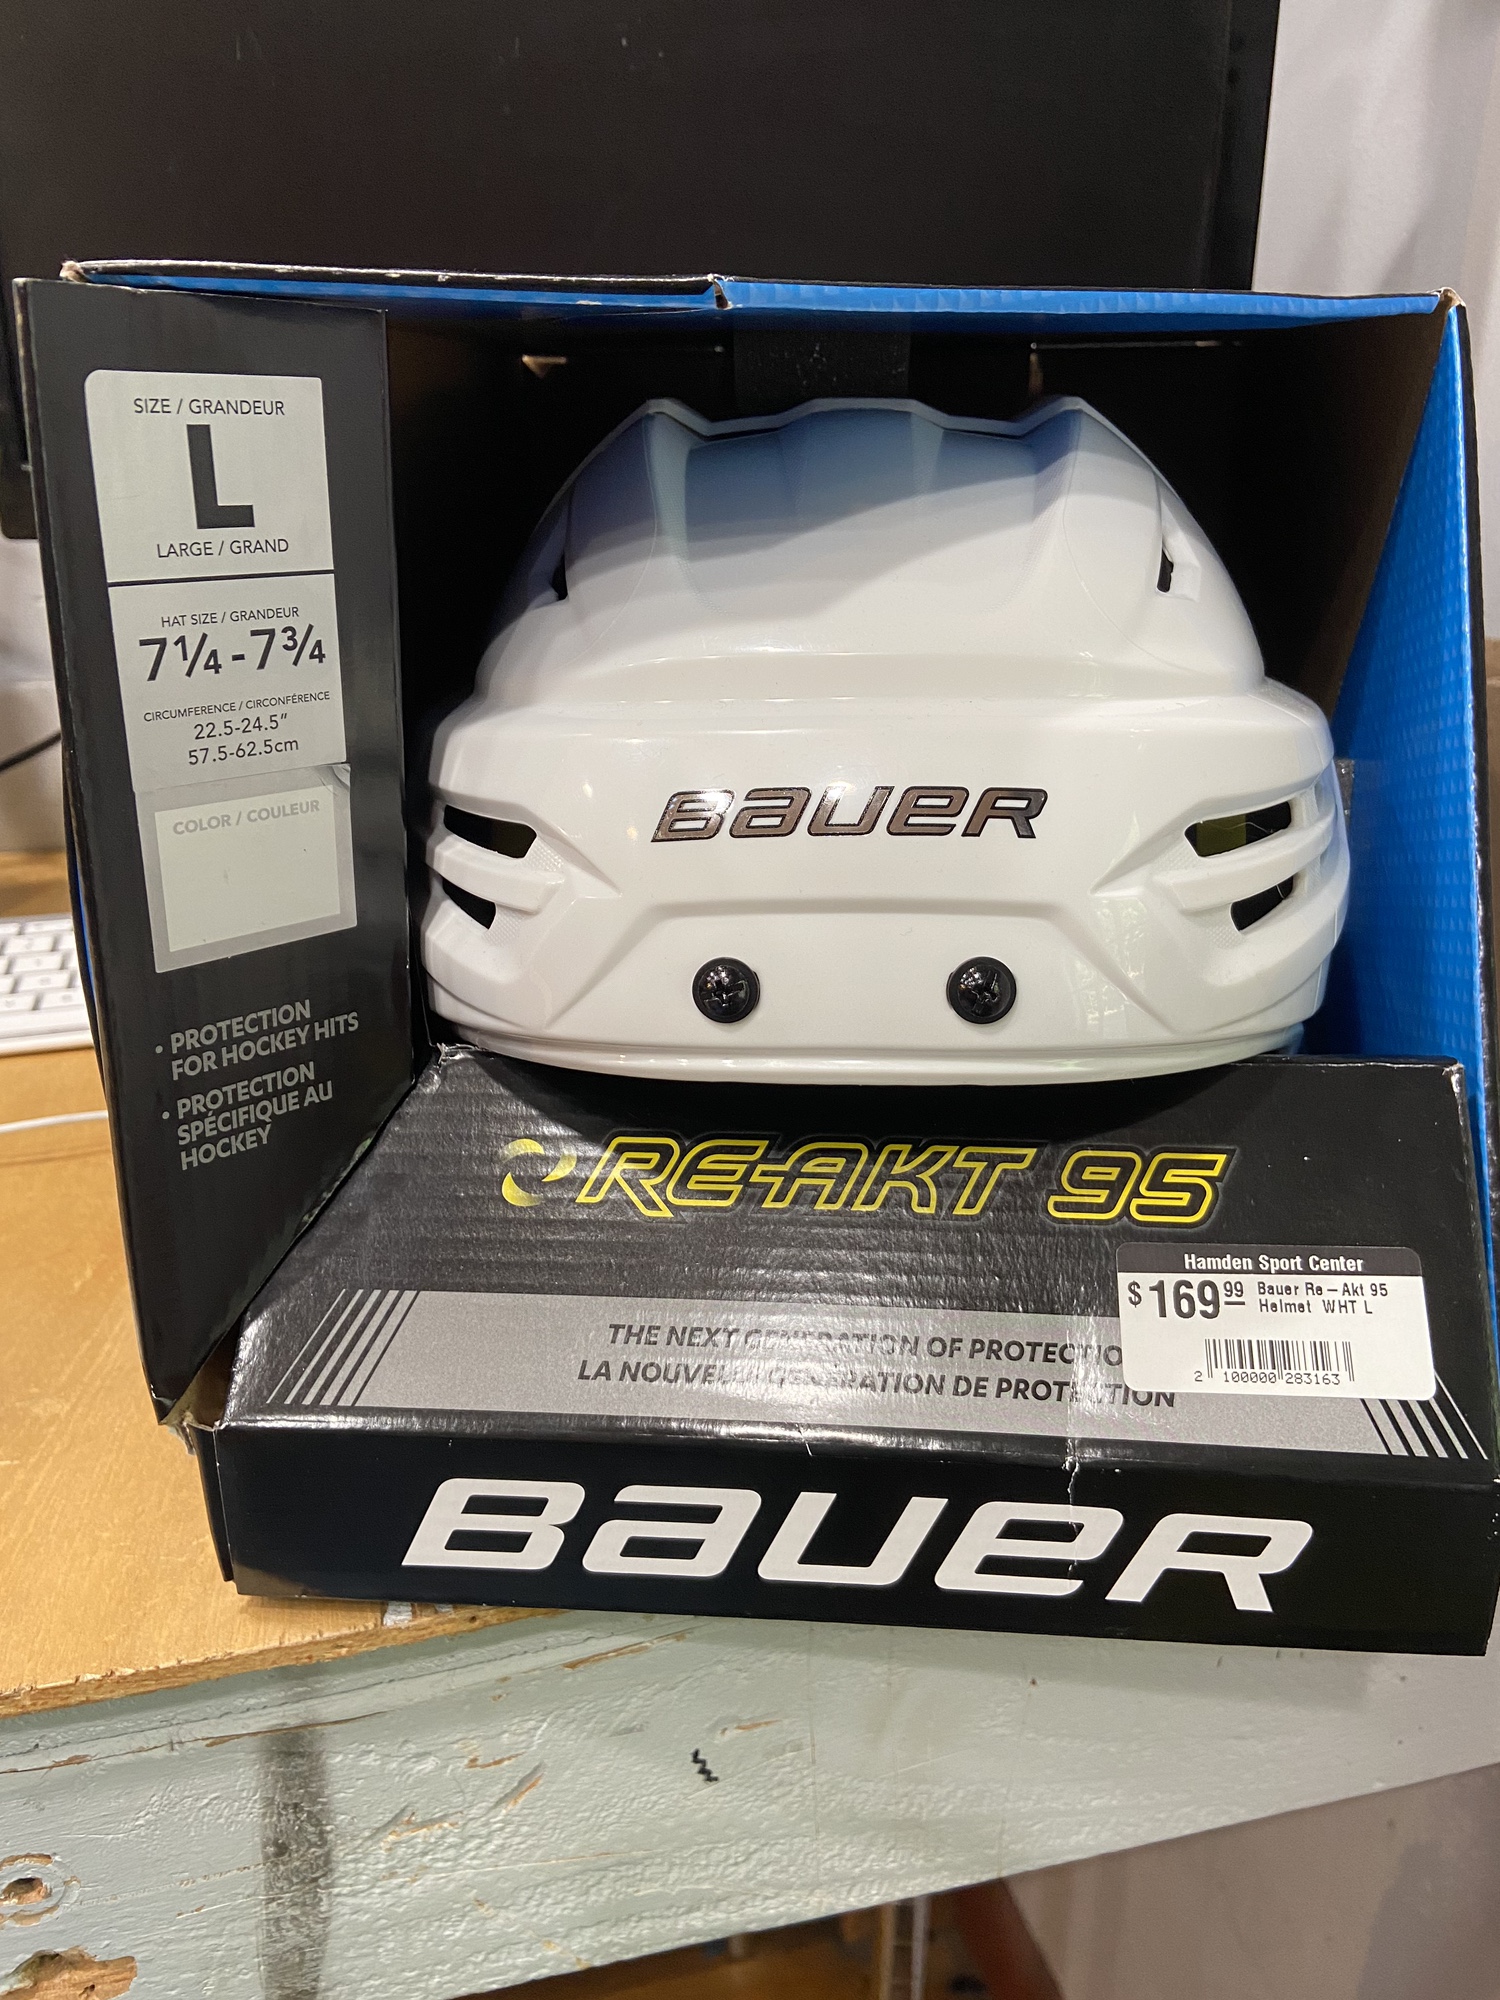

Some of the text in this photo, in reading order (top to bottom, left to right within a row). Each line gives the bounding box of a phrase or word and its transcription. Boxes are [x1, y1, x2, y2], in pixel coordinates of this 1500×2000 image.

[133, 398, 285, 416] SIZE / GRANDEUR
[186, 423, 255, 529] L
[156, 538, 289, 559] LARGE / GRAND
[161, 607, 300, 628] HAT SIZE / GRANDEUR
[143, 702, 236, 722] CIRCUMFERENCE
[245, 690, 330, 710] CIRCONFÉRENCE
[188, 738, 299, 766] 57.5-62.5cm
[173, 799, 320, 836] COLOR / COULEUR
[170, 999, 311, 1054] PROTECTION
[172, 1012, 359, 1081] FOR HOCKEY HITS
[177, 1061, 316, 1119] PROTECTION
[178, 1080, 334, 1147] SPÉCIFIQUE AU
[181, 1124, 272, 1171] HOCKEY
[575, 1135, 1228, 1224] RE-AKT 95
[1184, 1253, 1364, 1274] Hamden Sport Center
[1257, 1281, 1299, 1297] Bauer
[1370, 1283, 1388, 1298] 95
[1259, 1298, 1373, 1314] Helmet WHT L
[609, 1323, 661, 1346] THE
[666, 1325, 740, 1348] NEXT
[926, 1337, 963, 1358] OF
[968, 1338, 1122, 1366] PROTECTIO
[577, 1359, 612, 1381] LA
[952, 1375, 989, 1398] DE
[1194, 1370, 1341, 1385] 2 100000 283163
